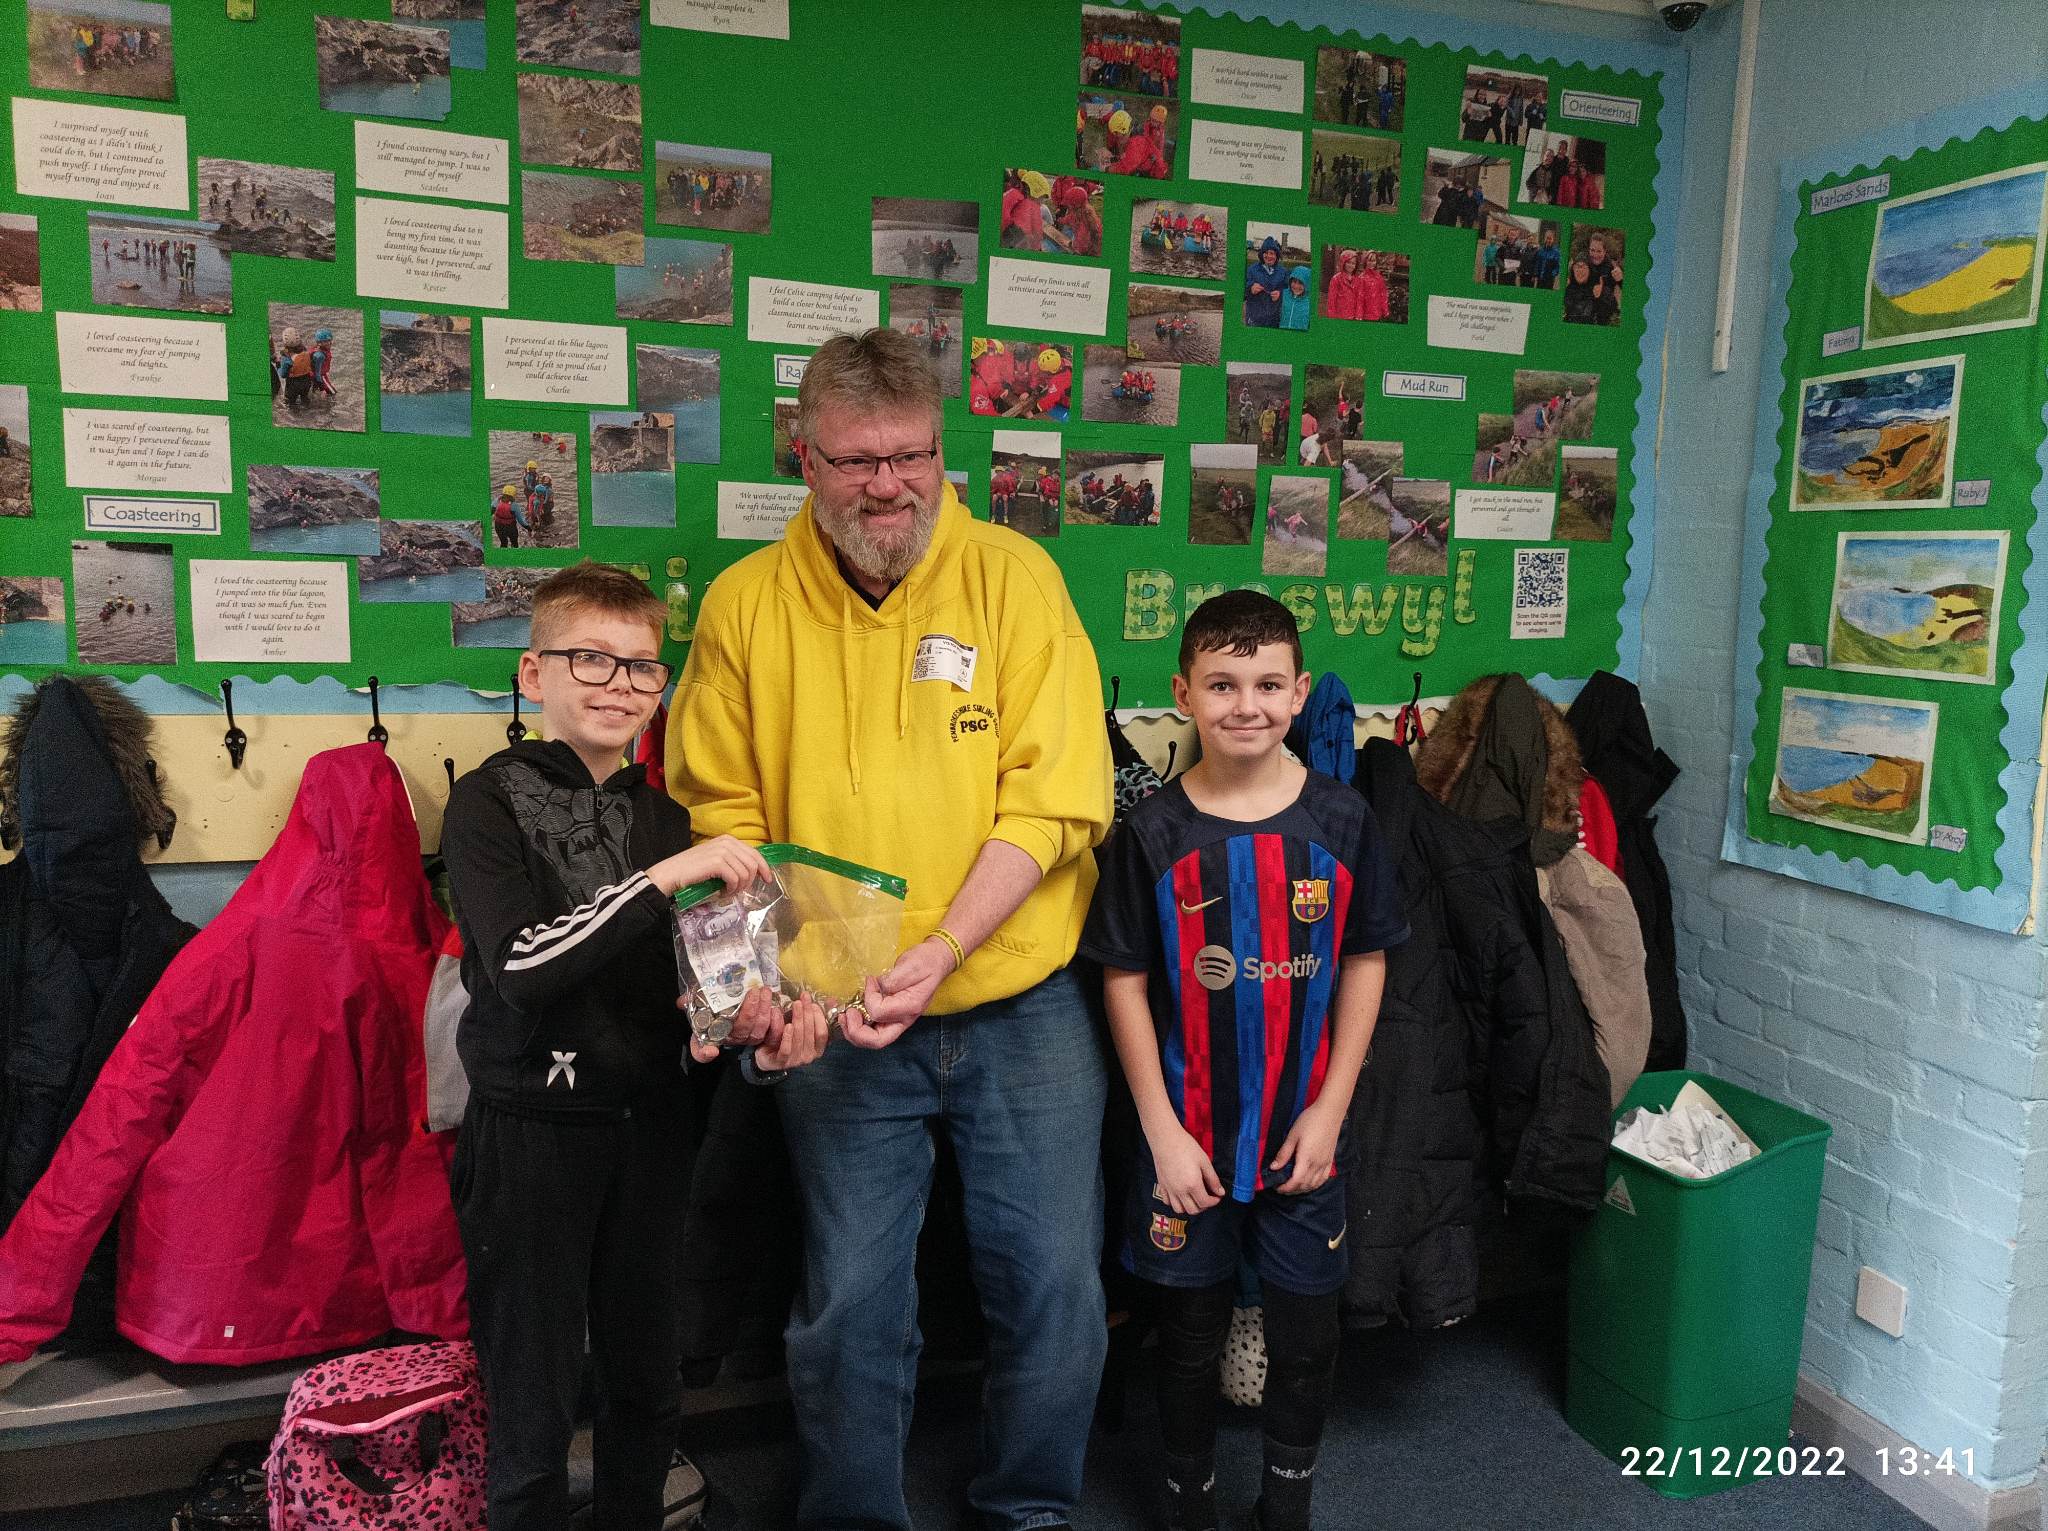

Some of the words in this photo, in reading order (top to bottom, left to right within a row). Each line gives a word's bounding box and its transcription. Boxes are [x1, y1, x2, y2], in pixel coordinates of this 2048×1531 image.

[1570, 100, 1631, 122] Orienteering
[61, 123, 99, 132] surprised
[101, 127, 128, 137] myself
[40, 159, 59, 167] push
[101, 164, 136, 175] therefore
[138, 170, 168, 178] proved
[1815, 190, 1852, 210] Marloes
[1855, 179, 1888, 198] Sands
[384, 241, 418, 253] daunting
[420, 245, 447, 254] because
[461, 251, 483, 260] jumps
[94, 332, 116, 341] loved
[117, 336, 161, 346] coasteering
[164, 336, 193, 346] because
[570, 339, 584, 347] blue
[586, 340, 608, 350] lagoon
[139, 347, 156, 357] fear
[158, 348, 168, 358] of
[167, 349, 200, 360] jumping
[520, 348, 544, 357] picked
[568, 353, 594, 361] courage
[1401, 379, 1425, 392] Mud
[1429, 380, 1448, 393] Run
[138, 423, 147, 433] of
[107, 434, 131, 444] happy
[139, 437, 181, 445] persevered
[182, 437, 211, 446] because
[747, 502, 758, 512] raft
[761, 503, 786, 513] building
[104, 506, 201, 527] Coasteering
[743, 514, 755, 522] raft
[256, 578, 297, 587] coasteering
[221, 588, 250, 598] jumped
[219, 612, 245, 621] though
[306, 612, 325, 622] begin
[960, 719, 988, 733] PSG
[1243, 954, 1322, 983] Spotify
